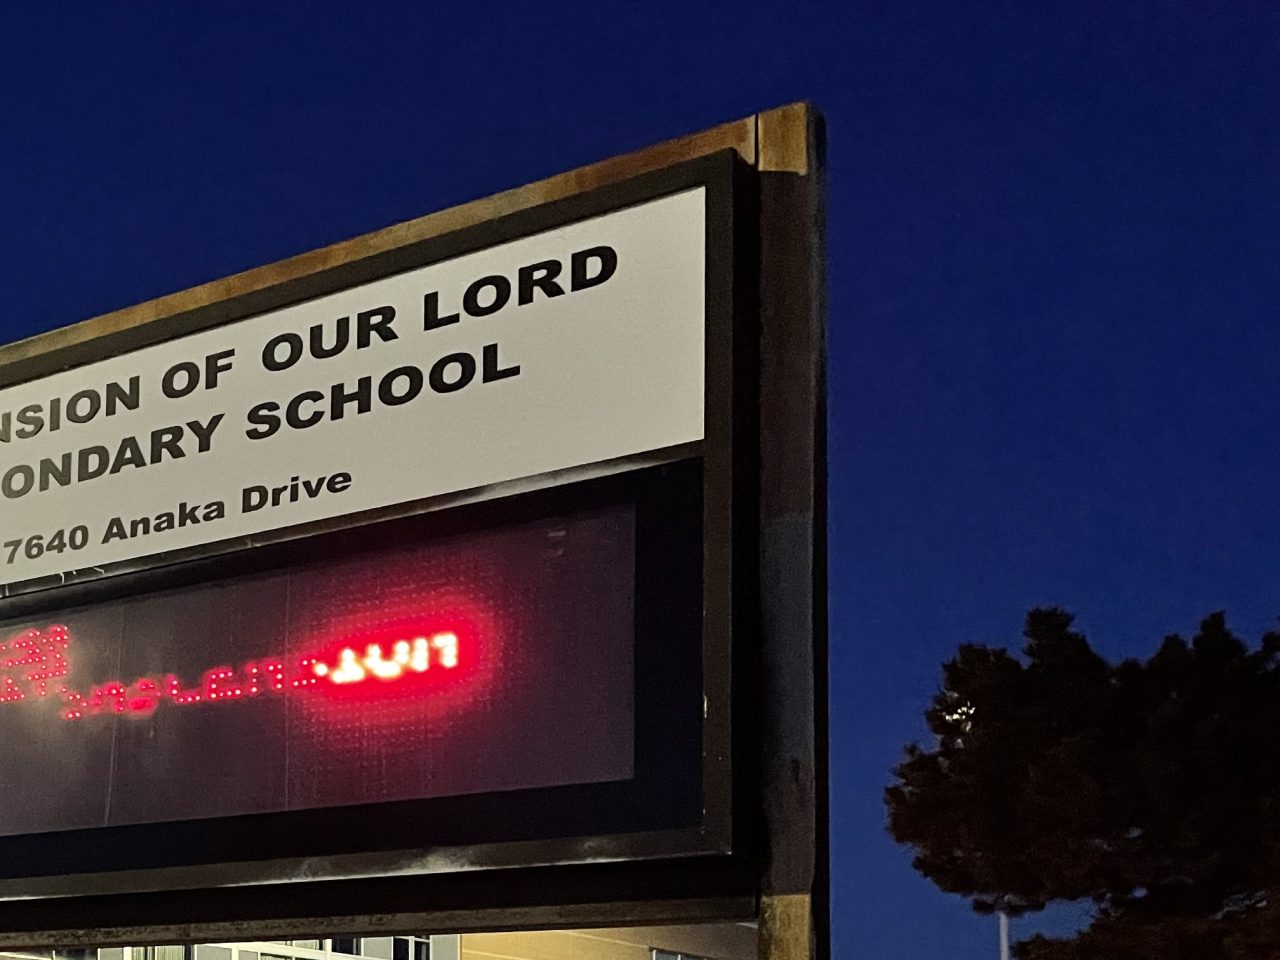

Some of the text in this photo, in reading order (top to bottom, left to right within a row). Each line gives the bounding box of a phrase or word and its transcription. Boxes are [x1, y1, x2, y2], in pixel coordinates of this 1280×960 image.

[161, 348, 236, 399] OF
[261, 305, 399, 372] OUR
[423, 245, 618, 332] LORD
[245, 343, 521, 440] SCHOOL
[3, 472, 352, 564] 7640 Anaka Drive
